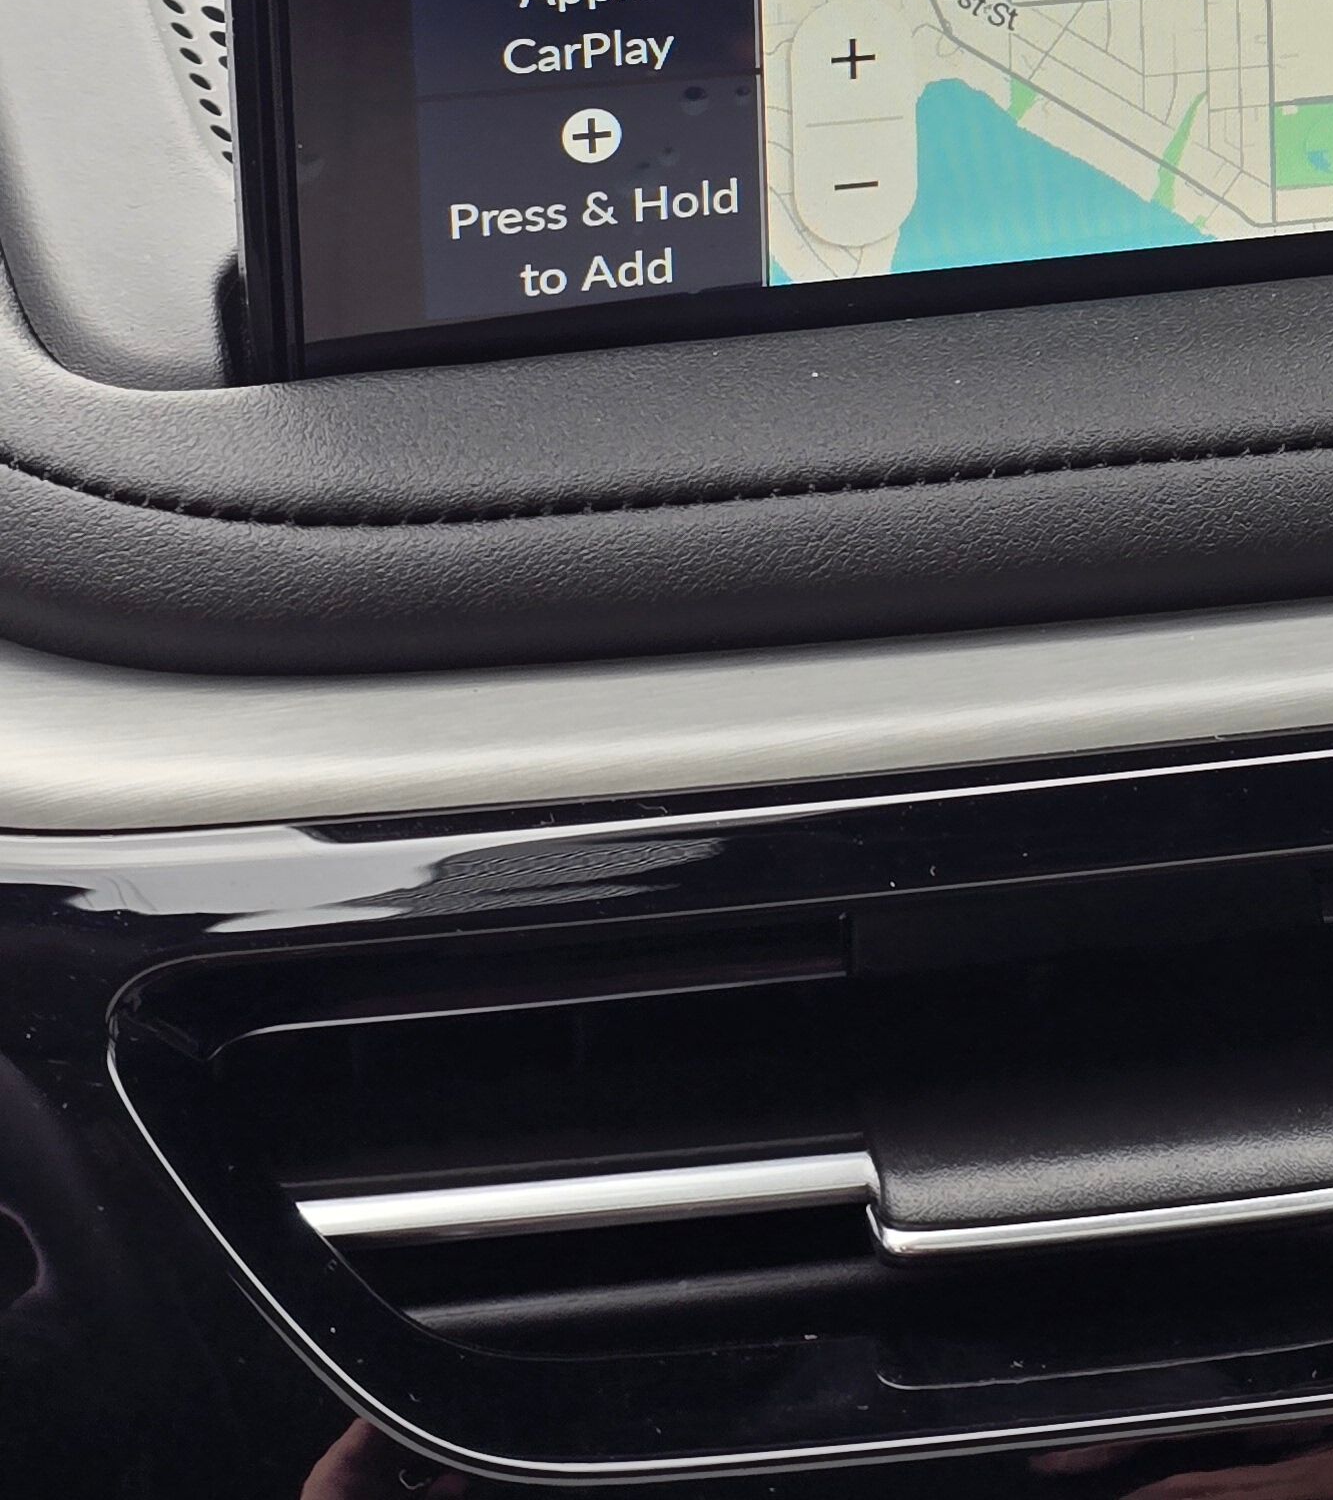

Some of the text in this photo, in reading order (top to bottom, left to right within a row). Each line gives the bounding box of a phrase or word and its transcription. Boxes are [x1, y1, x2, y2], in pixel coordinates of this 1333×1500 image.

[988, 2, 1018, 31] St
[502, 30, 674, 74] CarPlay
[449, 178, 739, 240] Press & Hold
[519, 249, 674, 298] to Add
